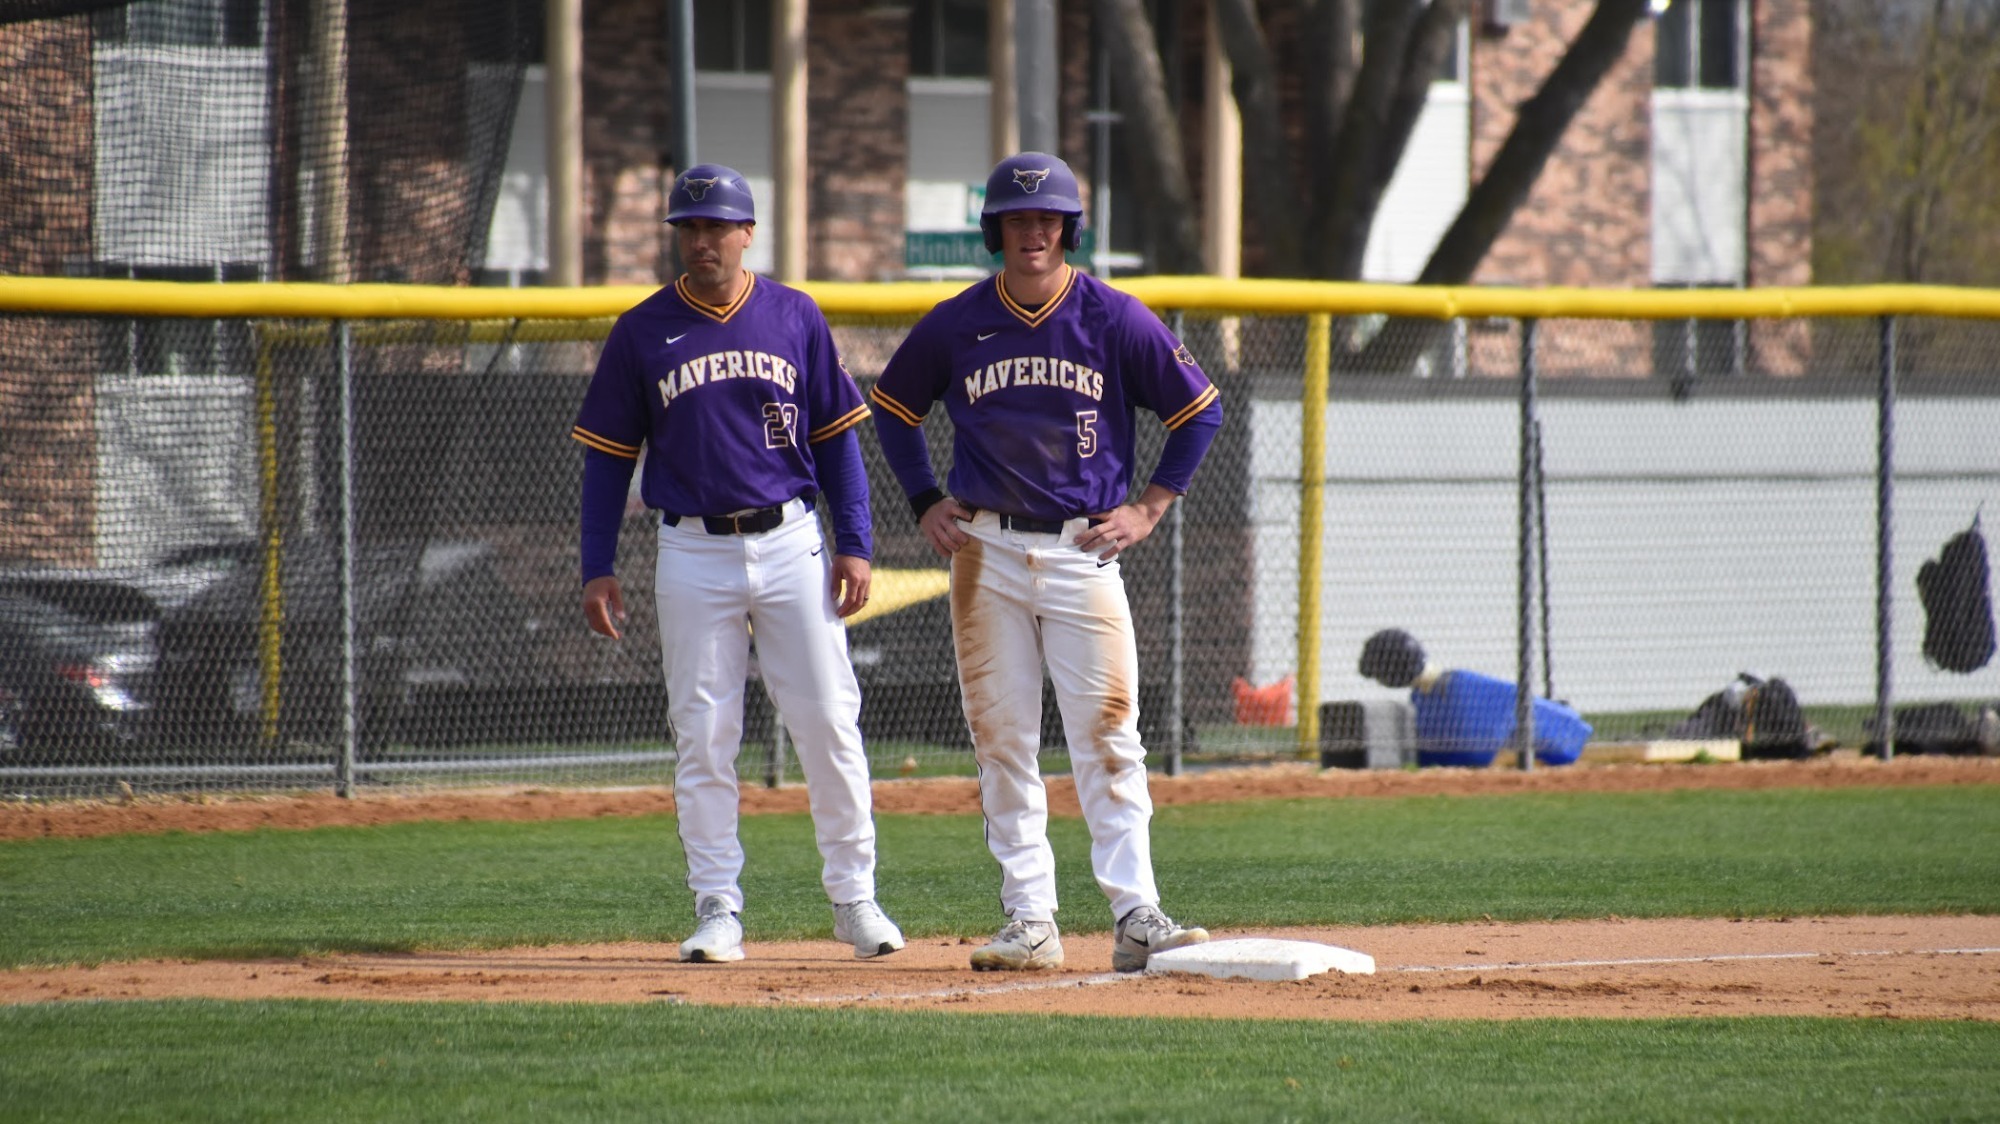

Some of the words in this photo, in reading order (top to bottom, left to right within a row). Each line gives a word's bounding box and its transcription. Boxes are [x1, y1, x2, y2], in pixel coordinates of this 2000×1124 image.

[658, 350, 798, 408] MAVERICKS
[965, 357, 1104, 405] MAVERICKS
[1076, 410, 1098, 458] 5
